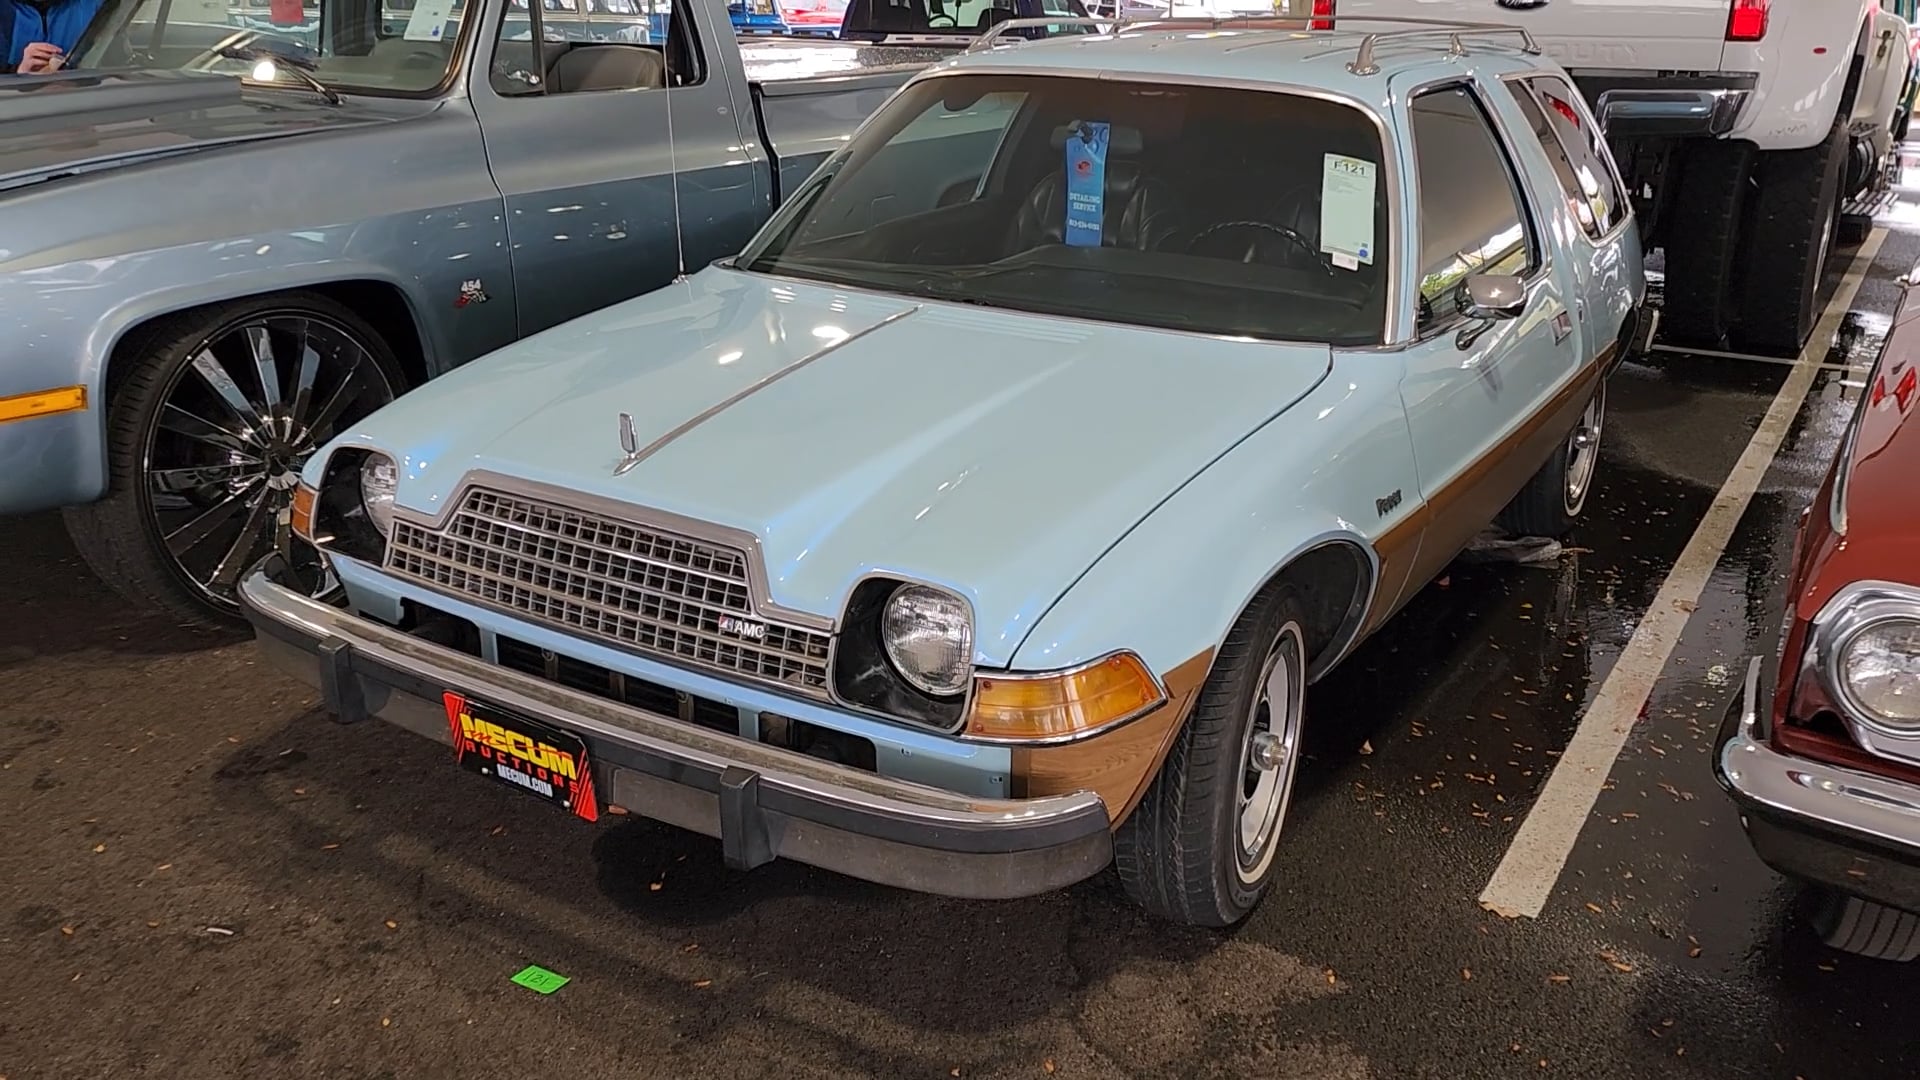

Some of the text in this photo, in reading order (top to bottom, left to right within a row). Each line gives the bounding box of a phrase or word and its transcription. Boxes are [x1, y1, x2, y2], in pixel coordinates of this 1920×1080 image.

[1334, 160, 1365, 176] F121
[461, 279, 481, 292] 454
[734, 620, 765, 638] AMC
[459, 713, 577, 780] MECUM
[465, 740, 579, 793] AUCTIONS
[496, 763, 553, 798] MECUM.COM
